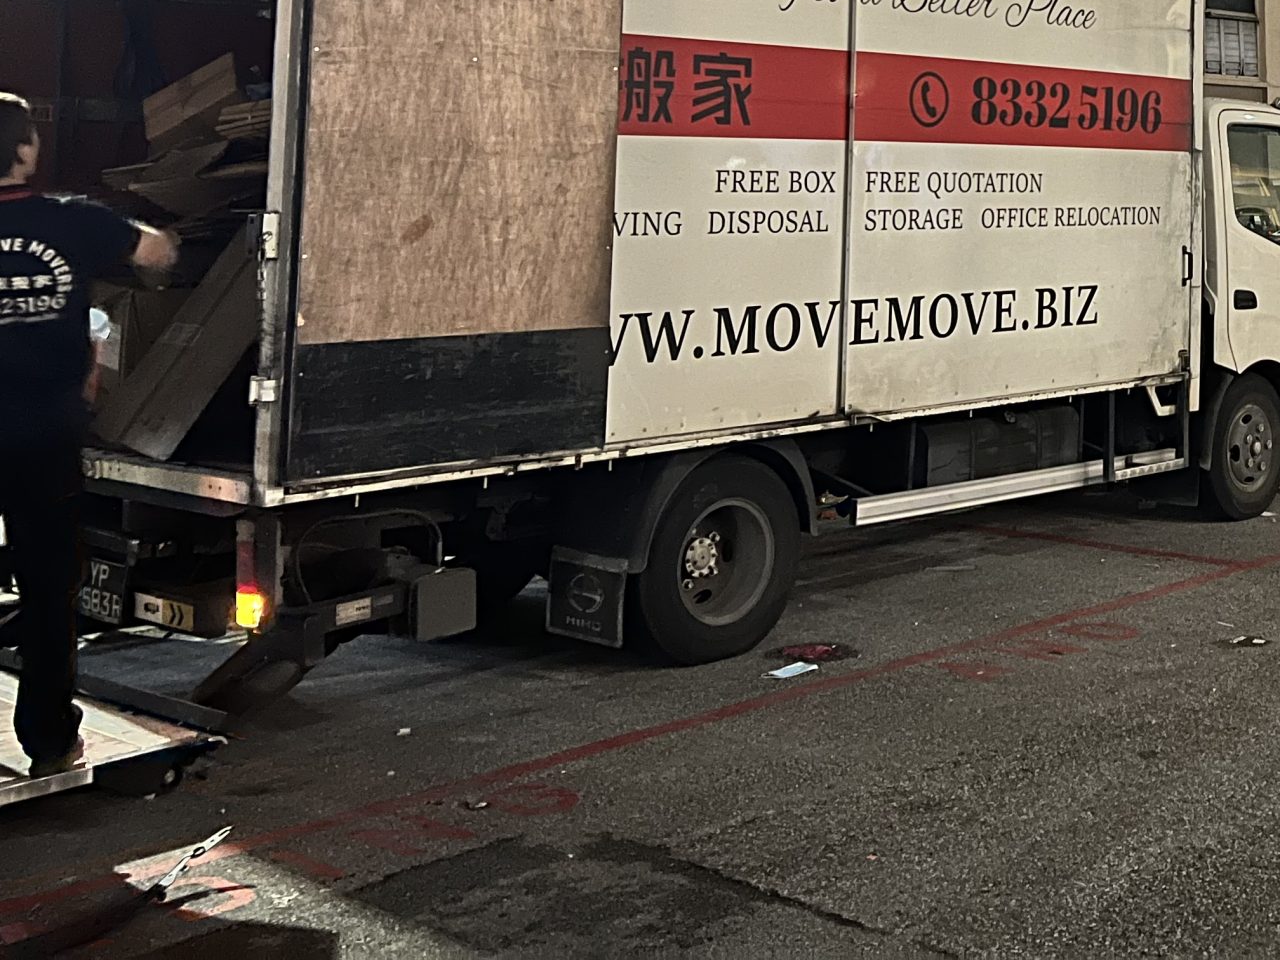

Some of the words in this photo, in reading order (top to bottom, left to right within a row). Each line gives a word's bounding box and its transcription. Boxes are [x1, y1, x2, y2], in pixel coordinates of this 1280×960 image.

[715, 170, 780, 193] FREE
[788, 170, 837, 193] BOX
[865, 171, 920, 193] FREE
[927, 171, 1043, 199] QUOTATION
[707, 210, 829, 234] DISPOSAL
[864, 208, 964, 231] STORAGE
[981, 207, 1049, 229] OFFICE
[1054, 206, 1161, 227] RELOCATION
[26, 240, 73, 292] MOVERS
[91, 561, 109, 587] YP
[77, 586, 121, 618] 583R
